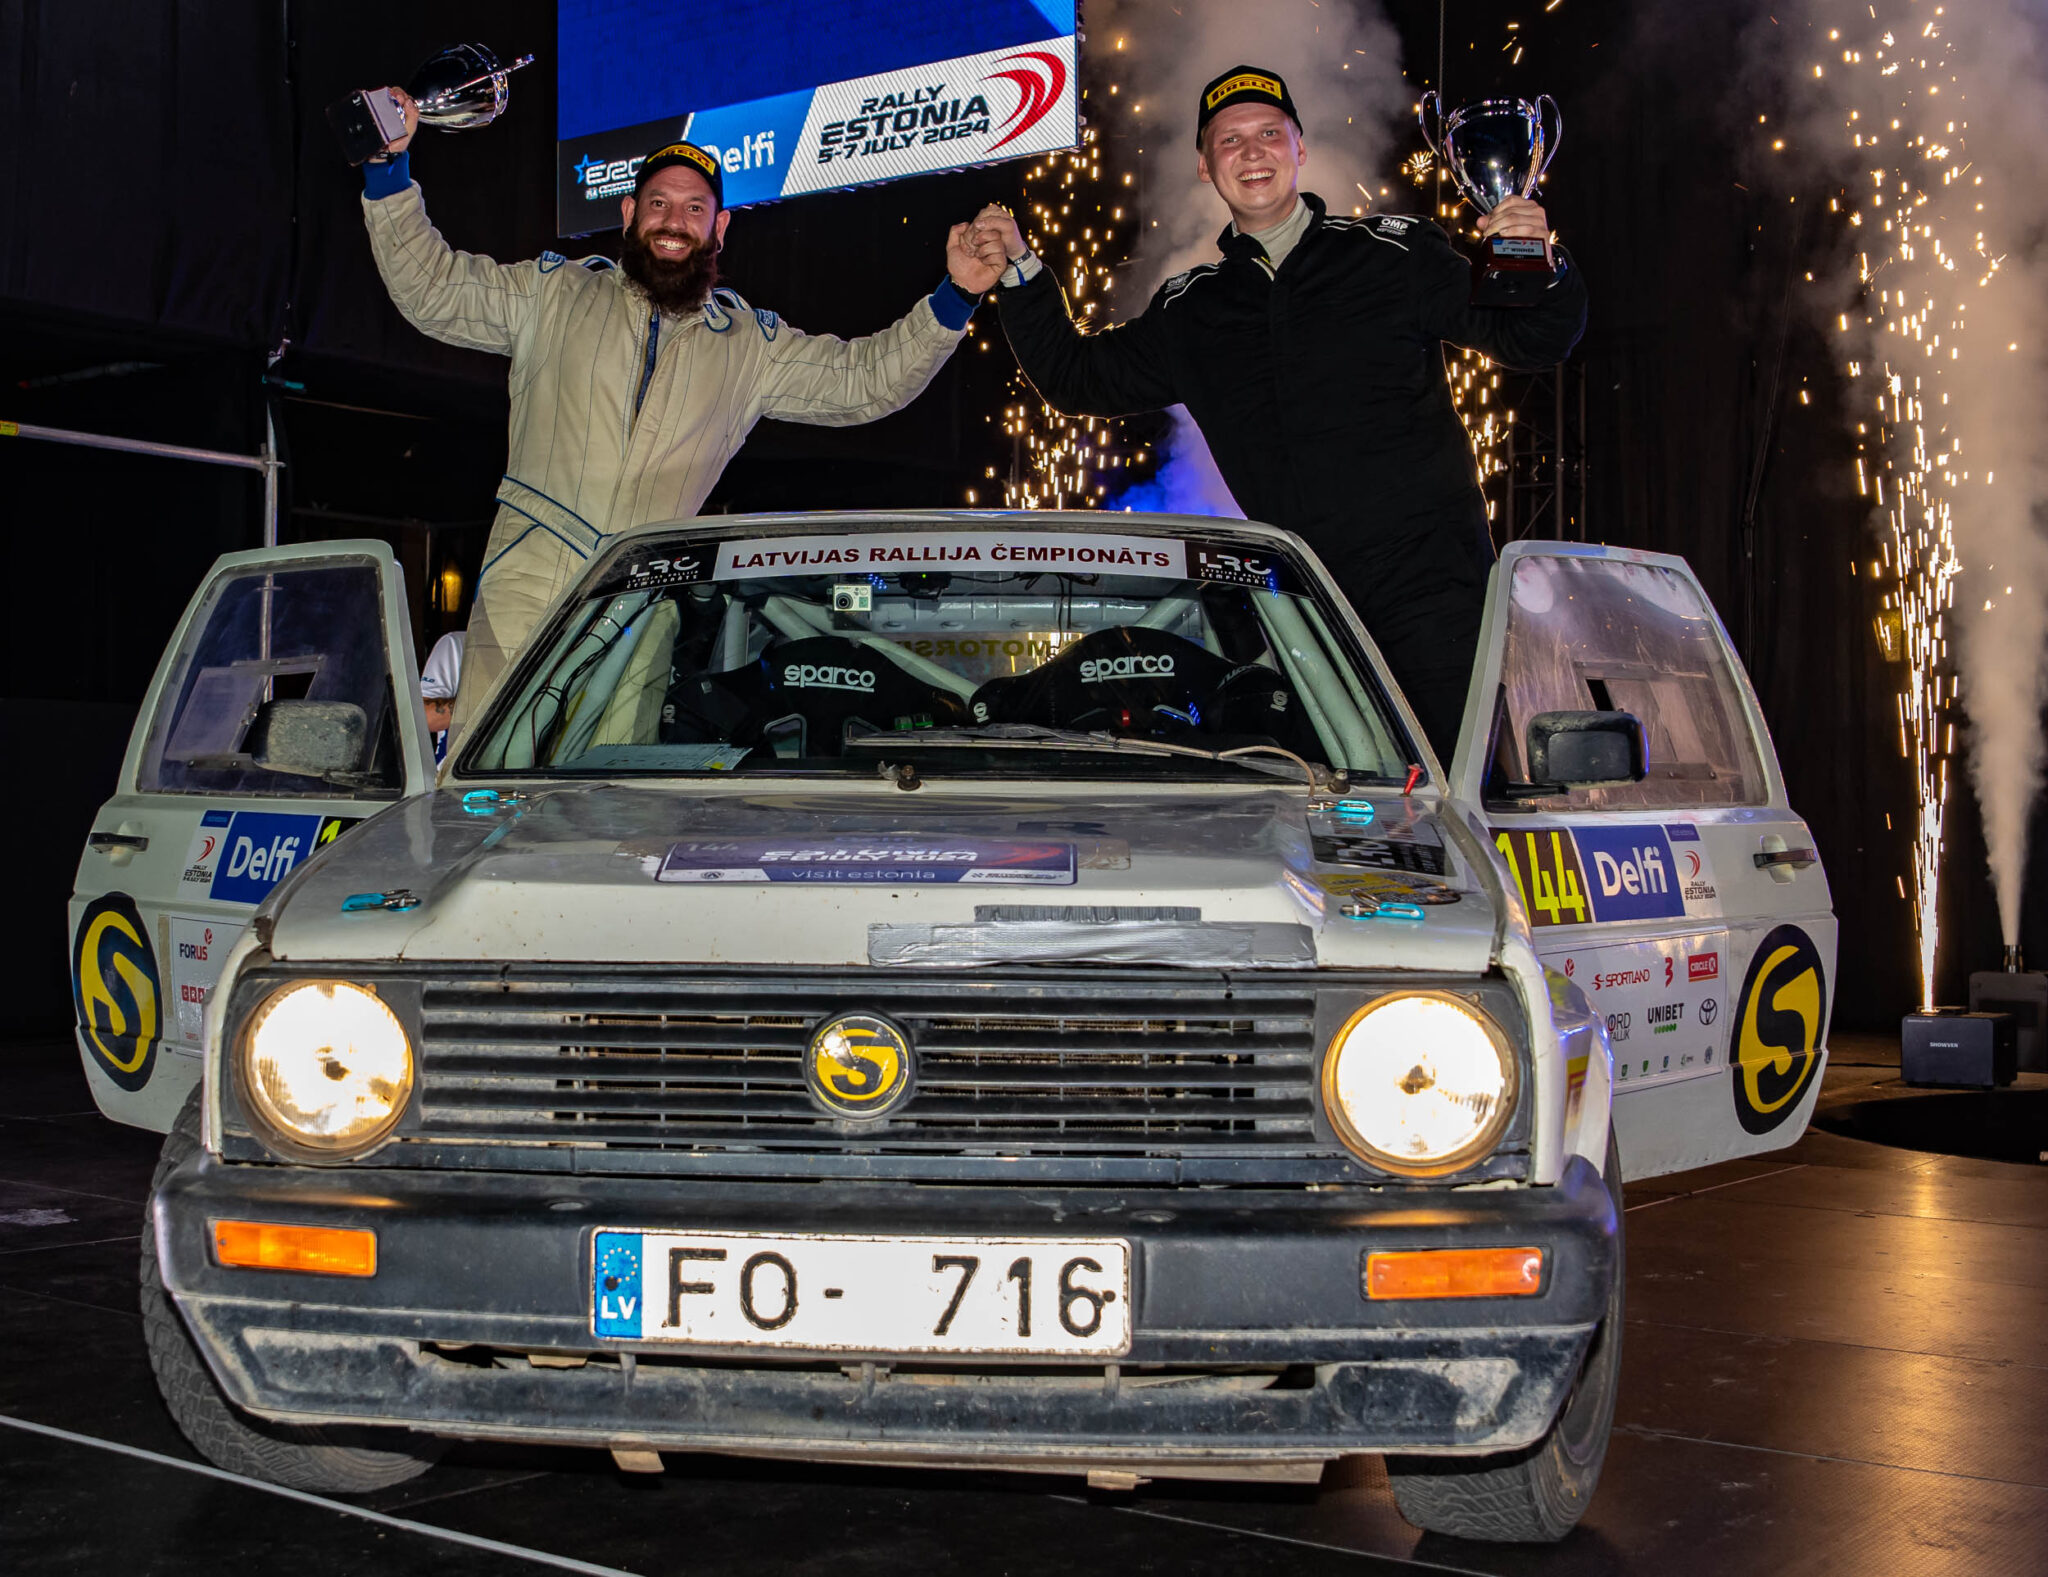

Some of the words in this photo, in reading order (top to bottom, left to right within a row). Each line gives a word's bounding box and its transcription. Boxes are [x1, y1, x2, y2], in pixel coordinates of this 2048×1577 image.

[861, 83, 946, 114] RALLY
[820, 95, 990, 146] ESTONIA
[818, 143, 857, 164] 5-7
[860, 131, 919, 156] JULY
[923, 118, 990, 145] 2024
[1381, 217, 1408, 230] OMP
[731, 548, 859, 569] LATVIJAS
[869, 546, 980, 562] RALLIJA
[991, 543, 1170, 567] ČEMPIONĀTS
[784, 664, 876, 690] sparco
[1080, 654, 1175, 683] sparco
[227, 835, 300, 882] Delfi
[792, 869, 843, 879] visit
[848, 869, 935, 880] estonia
[1496, 832, 1586, 925] 144
[1593, 847, 1669, 897] Delfi
[1685, 886, 1716, 895] ESTONIA
[179, 943, 208, 960] FORUS
[1605, 968, 1650, 988] SPORTLAND
[1690, 961, 1709, 973] CIRCLE
[1606, 1012, 1631, 1032] ORD
[1647, 1002, 1685, 1024] UNIBET
[601, 1296, 636, 1320] LV
[931, 1255, 1105, 1338] 716
